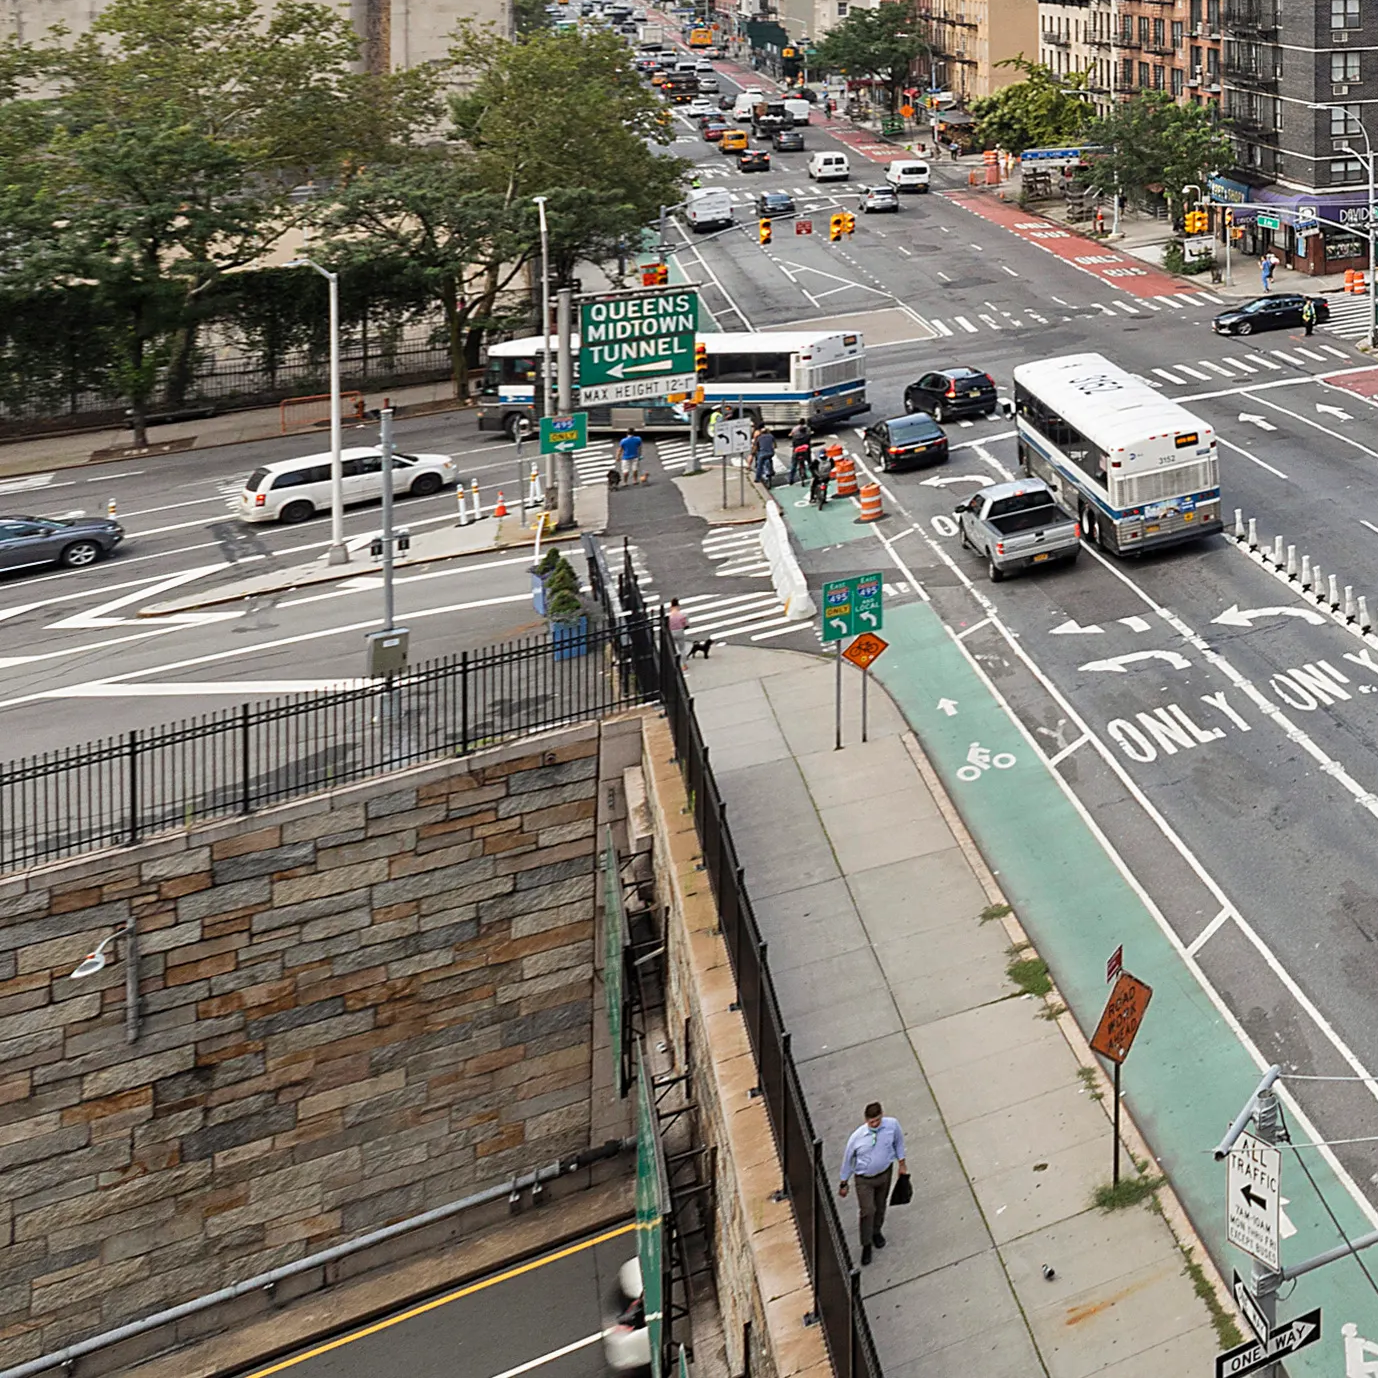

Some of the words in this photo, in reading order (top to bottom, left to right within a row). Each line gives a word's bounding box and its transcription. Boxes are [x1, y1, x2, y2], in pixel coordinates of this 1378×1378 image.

[1074, 255, 1124, 265] ONLY
[1102, 267, 1148, 277] BUS
[590, 294, 691, 322] QUEENS
[587, 313, 694, 343] MIDTOWN
[589, 336, 688, 364] TUNNEL
[583, 388, 609, 403] MAX
[615, 381, 660, 398] HEIGHT
[551, 431, 575, 441] ONLY
[553, 421, 575, 430] 495
[1158, 454, 1176, 465] 3152
[829, 594, 848, 603] 495
[860, 587, 877, 596] 495
[826, 606, 849, 616] ONLY
[855, 602, 880, 612] LOCAL
[1107, 691, 1252, 763] ONLY
[1107, 986, 1136, 1019] ROAD
[1107, 1001, 1137, 1035] WORK
[1107, 1018, 1138, 1052] AHEAD
[1241, 1138, 1268, 1169] ALL
[1231, 1152, 1278, 1194] TRAFFIC
[1230, 1348, 1262, 1373] ONE
[1275, 1323, 1308, 1353] WAY
